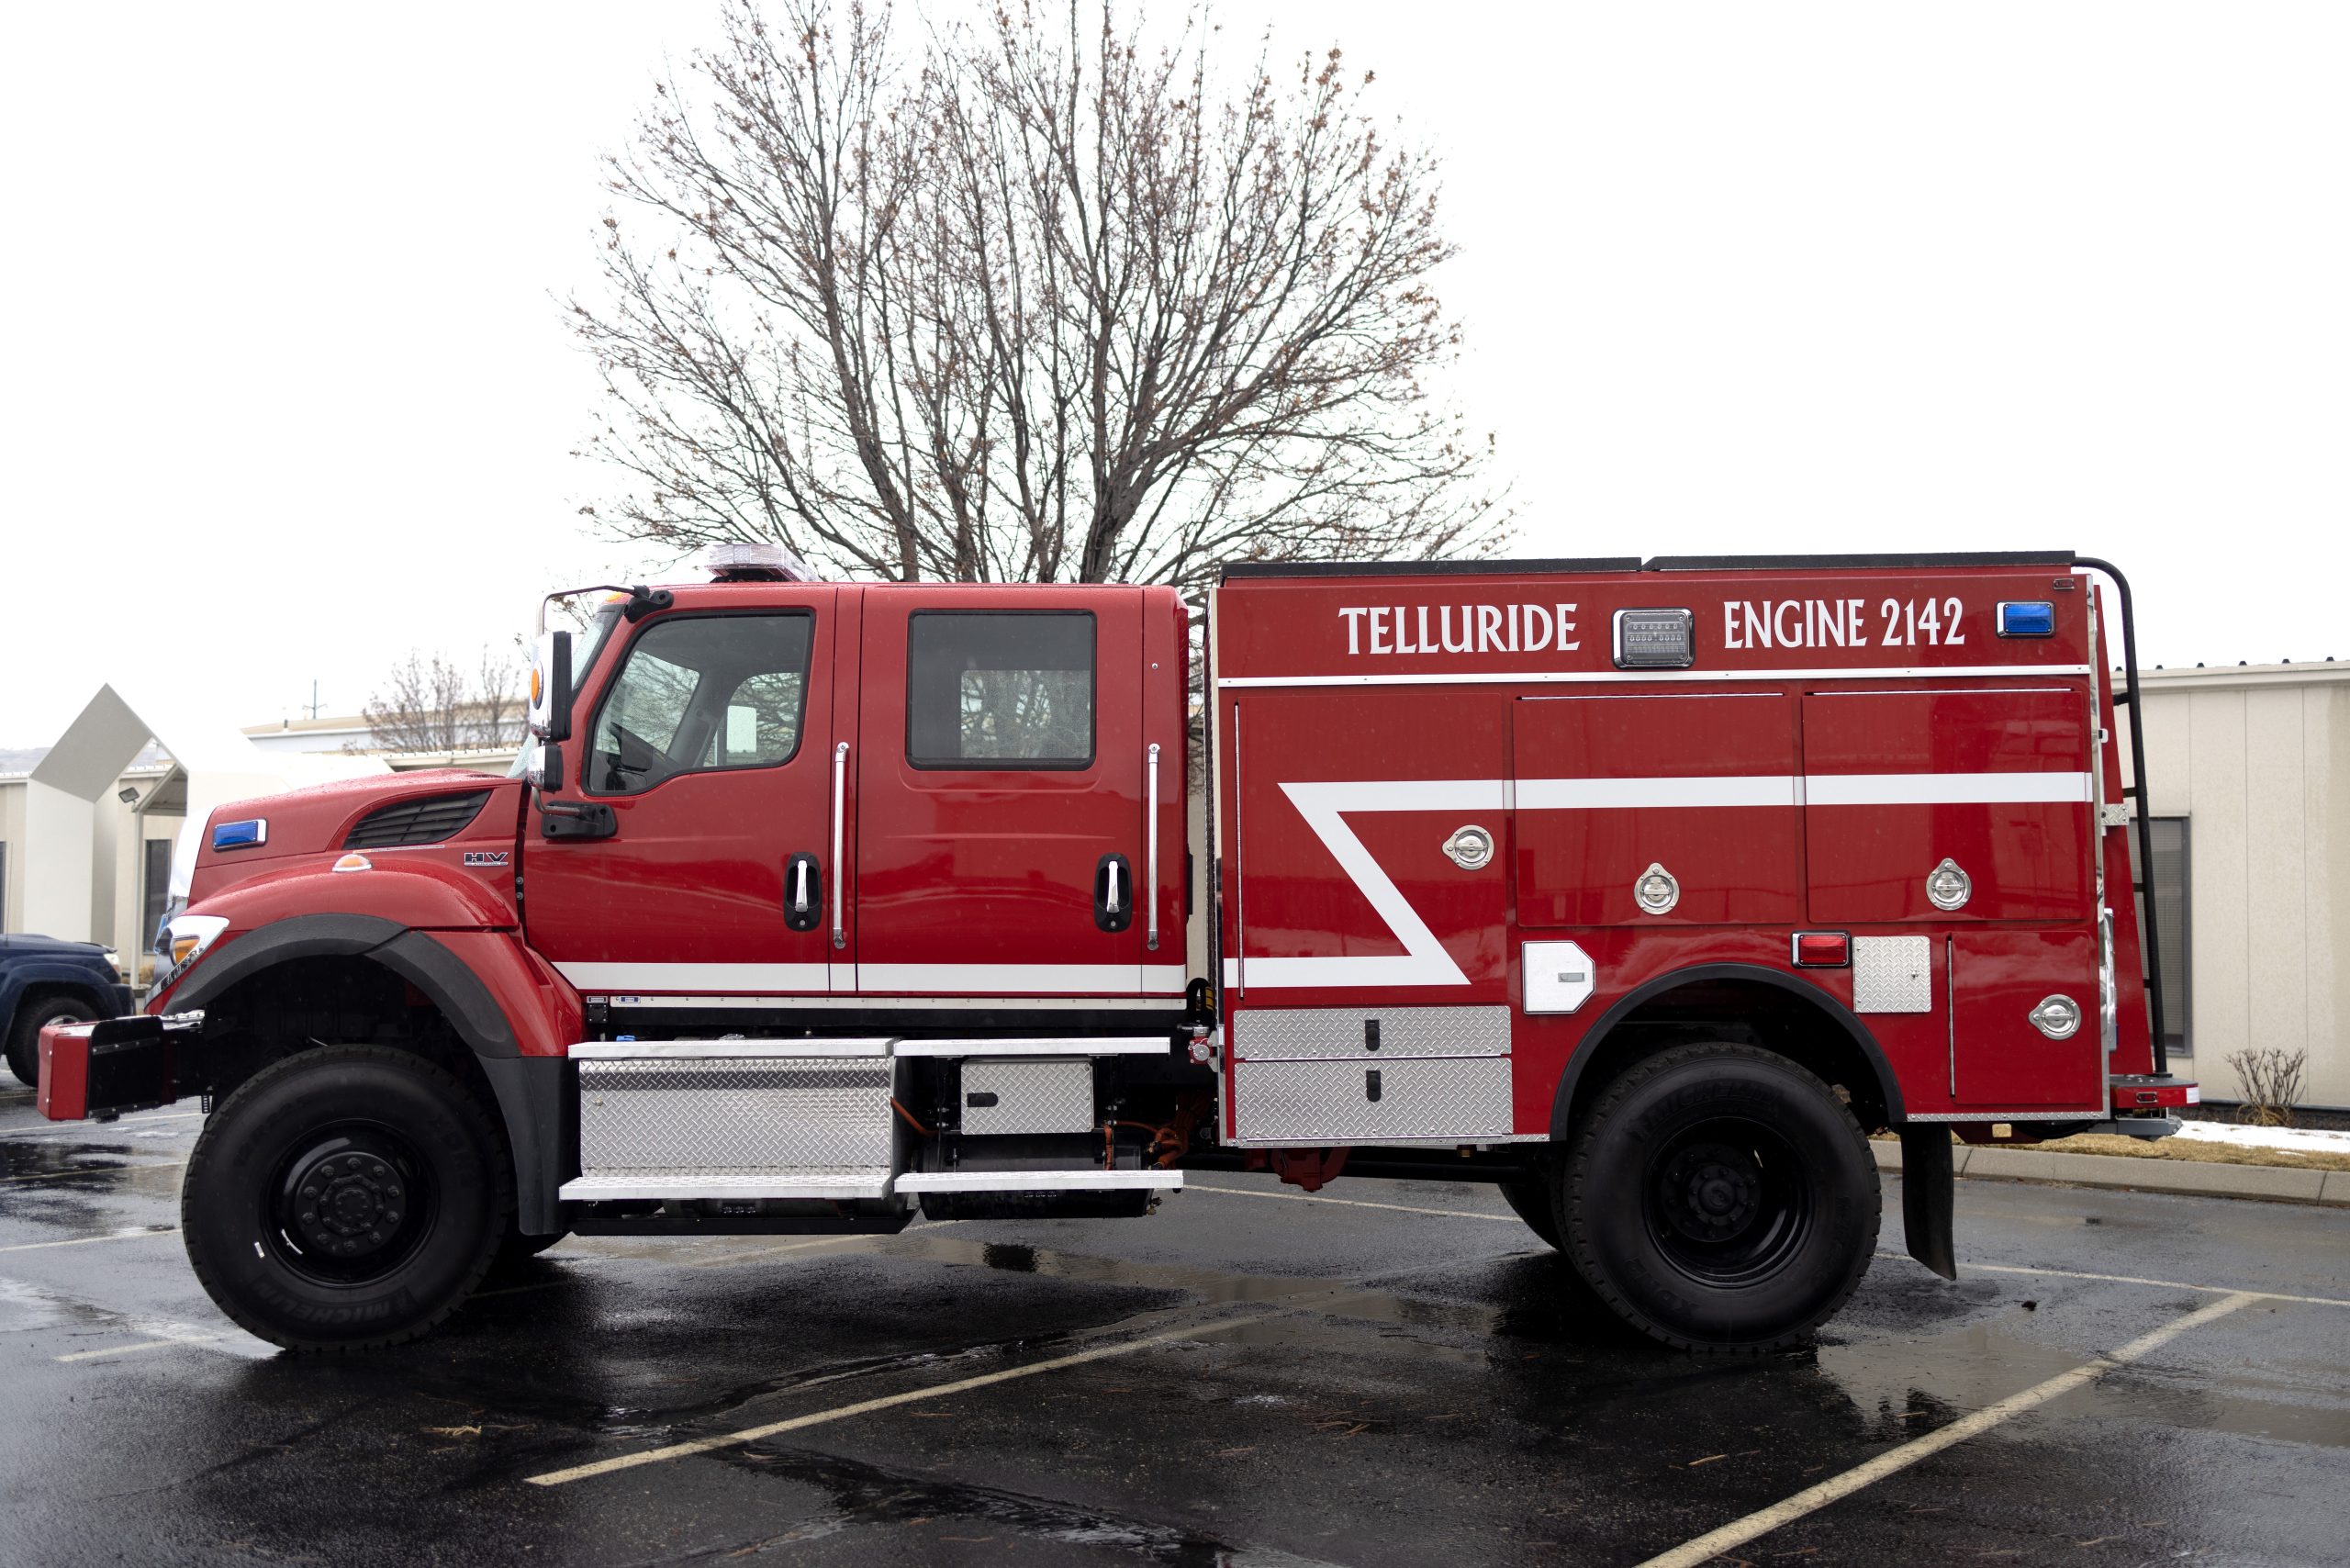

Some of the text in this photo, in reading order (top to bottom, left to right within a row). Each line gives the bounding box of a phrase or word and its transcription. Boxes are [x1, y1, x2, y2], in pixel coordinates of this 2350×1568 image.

[1337, 603, 1581, 655] TELLURIDE
[1723, 597, 1965, 649] ENGINE 2142
[464, 852, 509, 863] HV
[252, 1277, 391, 1324] MICHELIN
